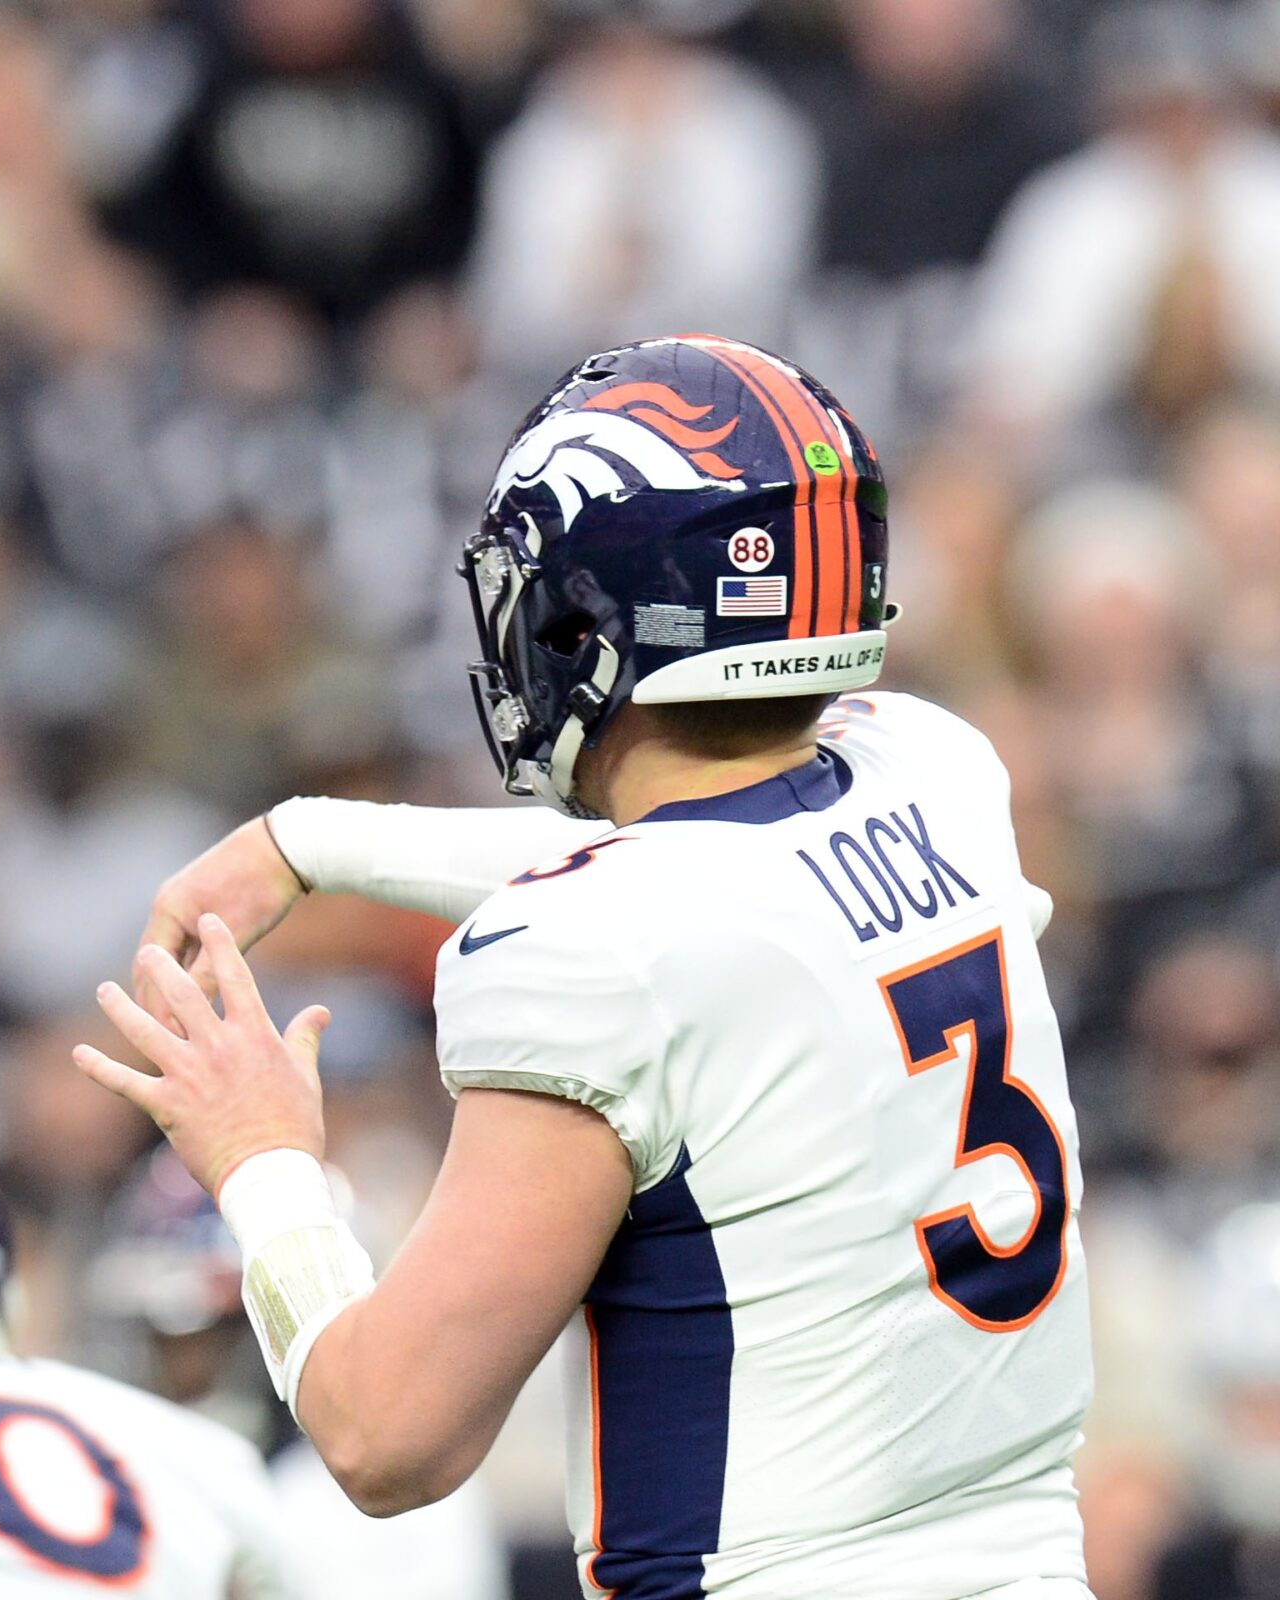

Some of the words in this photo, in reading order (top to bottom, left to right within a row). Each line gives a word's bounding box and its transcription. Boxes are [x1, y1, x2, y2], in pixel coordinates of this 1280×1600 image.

[734, 537, 769, 562] 88
[870, 566, 881, 598] 3
[724, 664, 742, 680] IT
[752, 657, 819, 676] TAKES
[825, 652, 852, 671] ALL
[857, 649, 871, 666] OF
[796, 803, 979, 942] LOCK
[876, 926, 1070, 1333] 3
